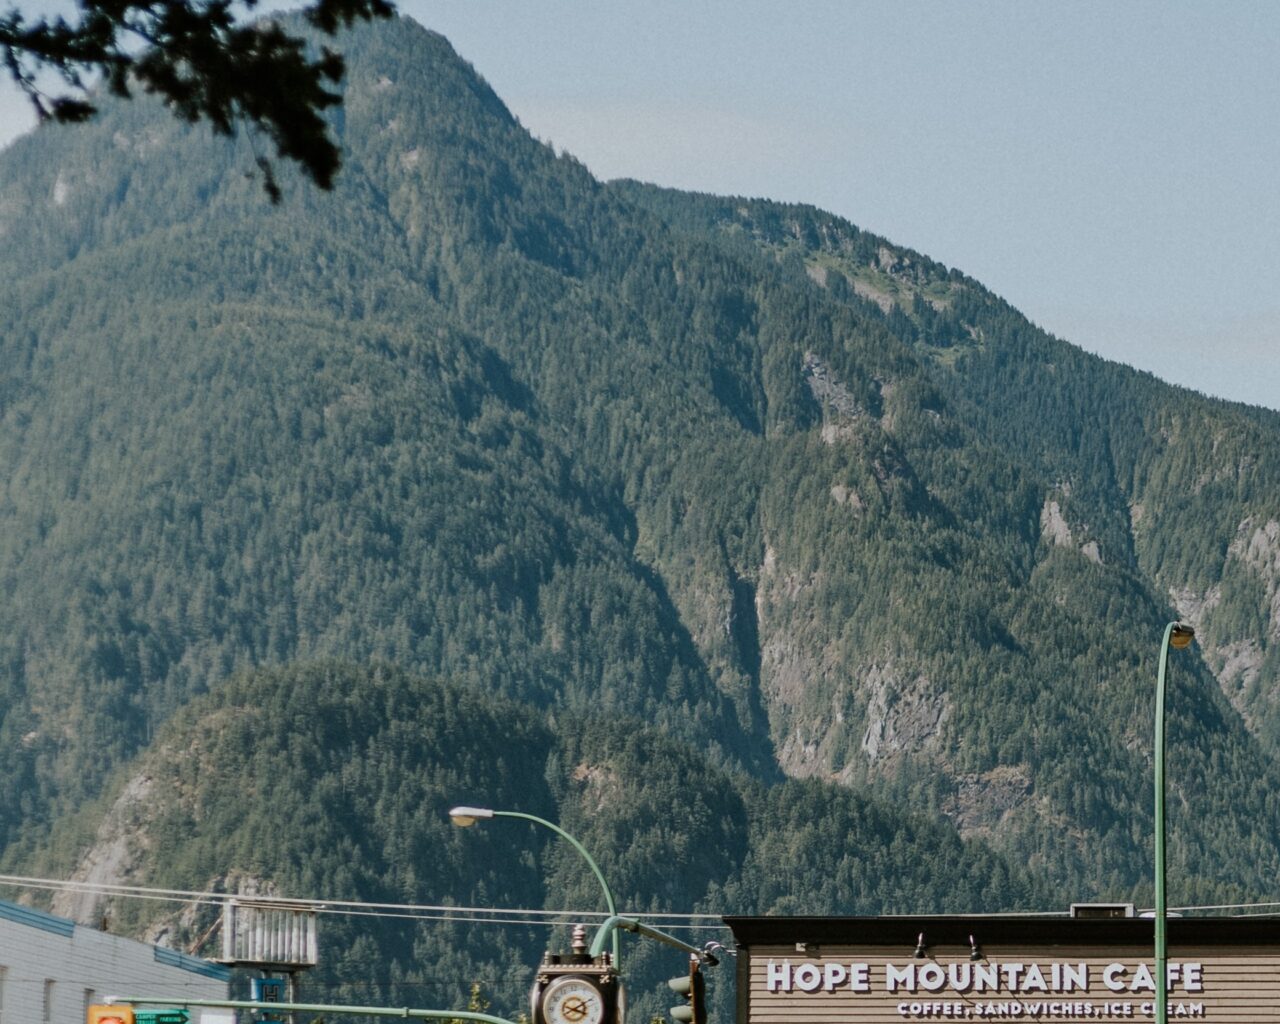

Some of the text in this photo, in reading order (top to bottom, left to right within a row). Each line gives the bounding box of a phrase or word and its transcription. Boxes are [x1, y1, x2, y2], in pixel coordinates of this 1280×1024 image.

[767, 962, 1202, 991] HOPE MOUNTAIN CAFE
[897, 1002, 1204, 1018] COFFEE, SANDWICHES, ICE CEAM
